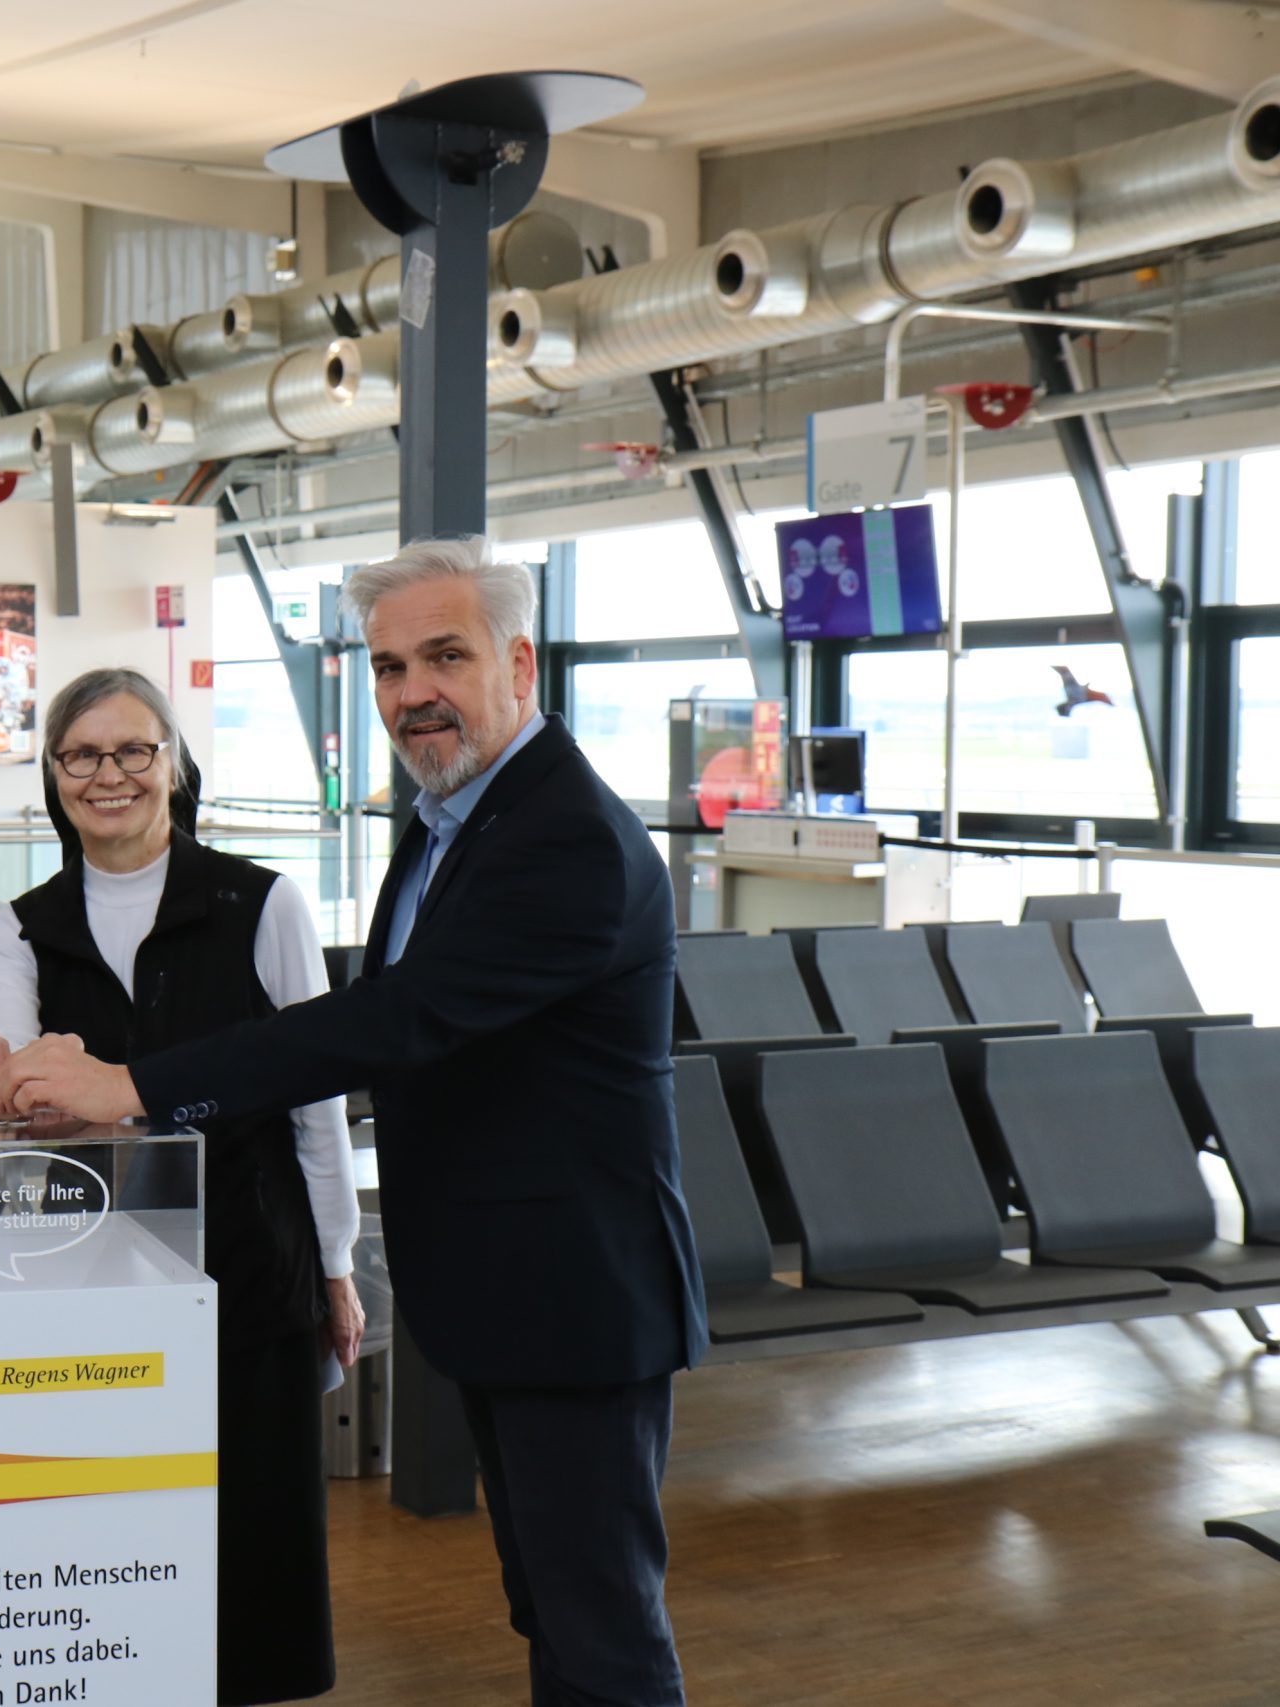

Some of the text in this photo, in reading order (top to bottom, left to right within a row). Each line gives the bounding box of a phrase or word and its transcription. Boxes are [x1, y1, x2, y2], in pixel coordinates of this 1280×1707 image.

[818, 434, 916, 503] Gate 7
[18, 1184, 44, 1202] für
[51, 1183, 84, 1201] Ihre
[1, 1362, 150, 1389] Regens Wagner
[54, 1560, 177, 1587] Menschen
[13, 1647, 56, 1667] uns
[66, 1637, 138, 1663] dabei.
[16, 1677, 87, 1704] Dank!
